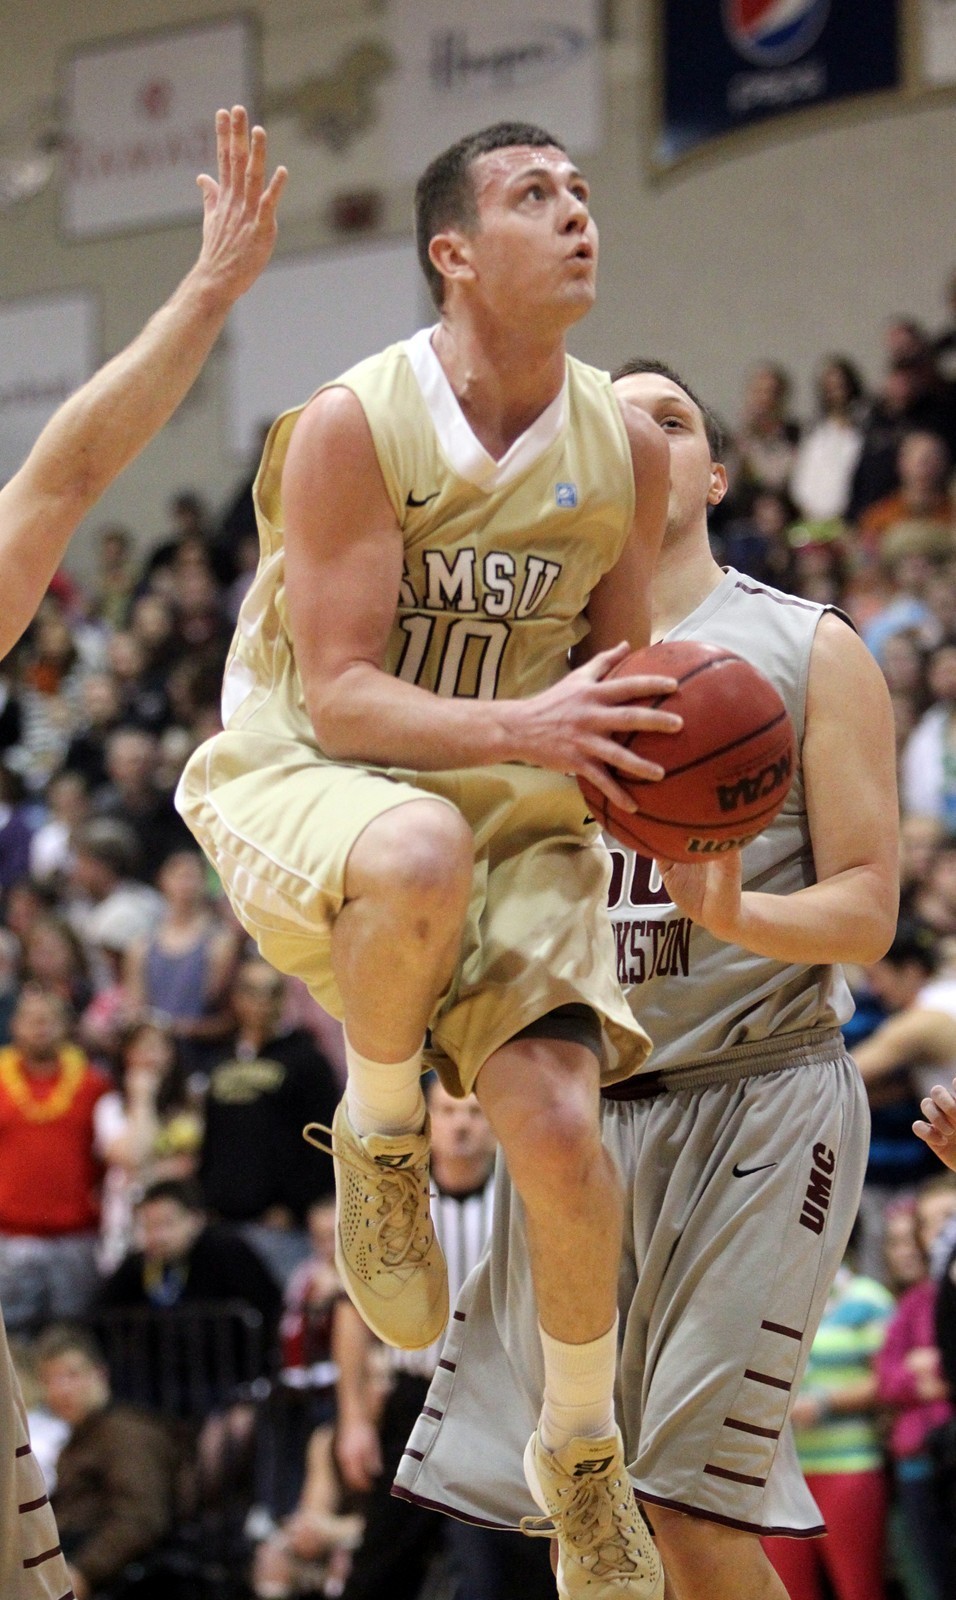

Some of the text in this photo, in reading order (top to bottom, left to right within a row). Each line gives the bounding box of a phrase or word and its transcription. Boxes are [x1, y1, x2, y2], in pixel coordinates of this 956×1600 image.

[395, 612, 512, 699] 10
[611, 917, 694, 985] KSTON
[798, 1141, 836, 1236] UMC
